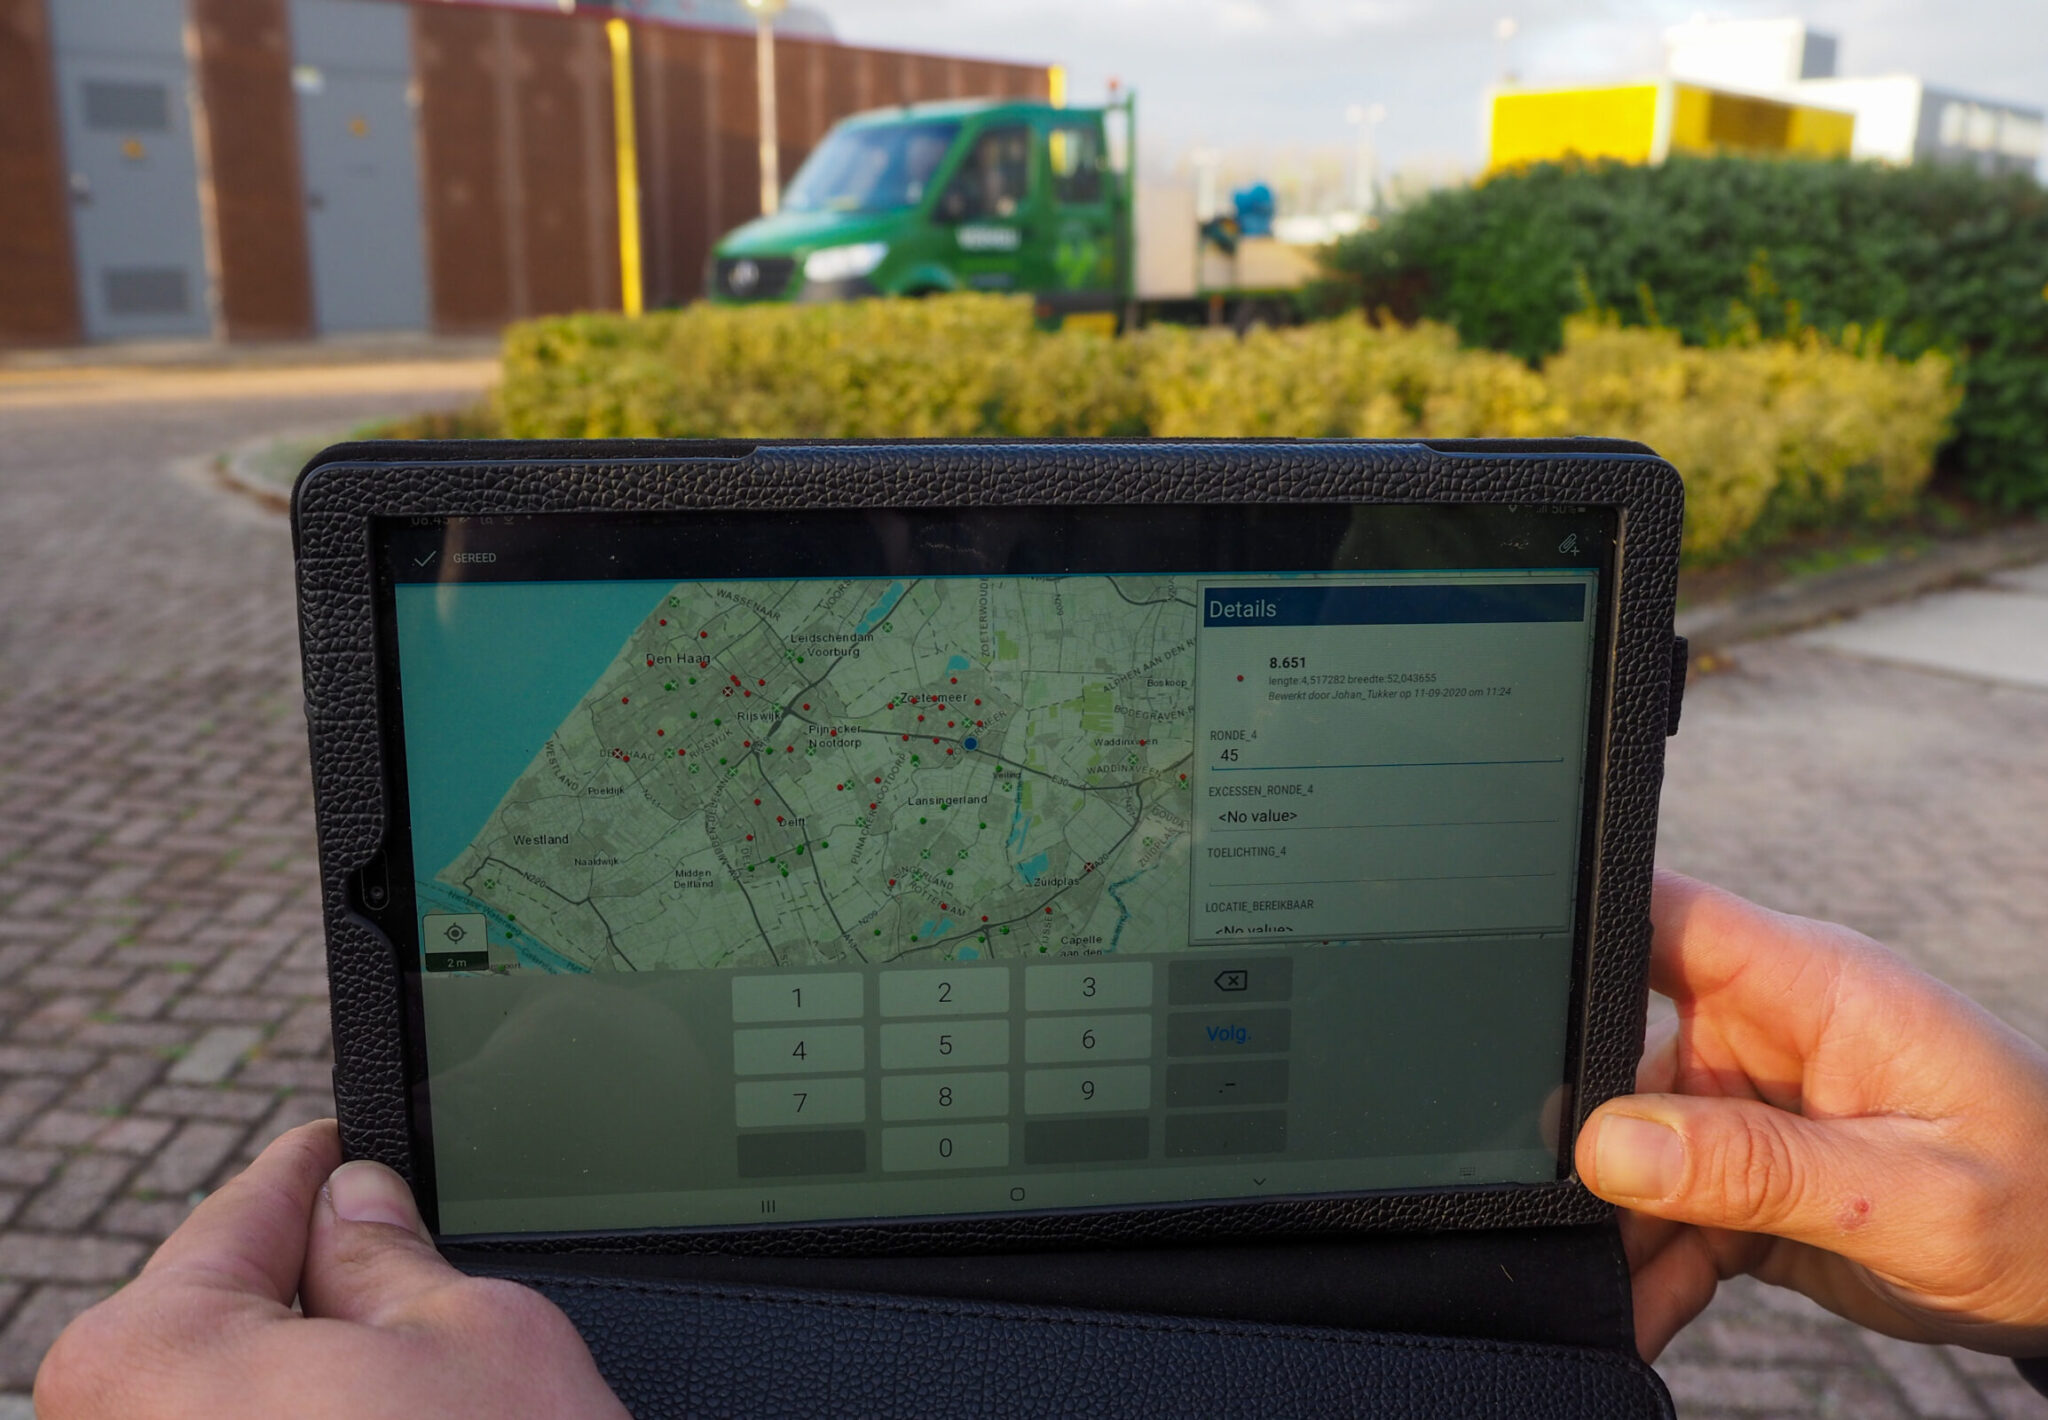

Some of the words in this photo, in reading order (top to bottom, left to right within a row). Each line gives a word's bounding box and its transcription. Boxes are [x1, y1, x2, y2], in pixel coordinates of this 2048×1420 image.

[453, 552, 497, 564] GEREED
[716, 587, 781, 622] WASSENAAR
[1210, 599, 1277, 619] Details
[790, 633, 875, 644] Leidschendam
[645, 653, 672, 665] Den
[676, 652, 711, 668] Haag
[807, 647, 860, 660] Voorburg
[1103, 667, 1141, 693] ALPHEN
[1143, 655, 1163, 672] AAN
[1164, 645, 1185, 661] DEN
[1269, 656, 1306, 669] 8.651
[1146, 679, 1187, 689] Boskoop
[900, 691, 968, 704] Zoetemeer
[1268, 691, 1306, 701] Bewerkt
[1308, 691, 1330, 701] door
[1400, 690, 1411, 701] op
[1415, 687, 1467, 698] 11-09-2020
[1469, 689, 1483, 697] om
[737, 710, 782, 723] Rijswijk
[1209, 728, 1257, 742] RONDE_4
[688, 727, 734, 760] RIJSWIJK
[808, 738, 862, 750] Nootdorp
[1220, 748, 1239, 762] 45
[545, 739, 580, 792] WESTLAND
[1086, 764, 1161, 778] WADDINXVEEN
[588, 785, 625, 797] Poeldijk
[1208, 784, 1314, 798] EXCESSEN_RONDE_4
[850, 750, 909, 865] PIJNACKERNOOTDORP
[907, 795, 988, 808] Lansingerland
[779, 818, 806, 828] Delft
[1218, 810, 1248, 824] <No
[1251, 809, 1298, 823] value>
[513, 834, 569, 846] Westland
[1207, 845, 1287, 859] TOELICHTING_4
[574, 857, 619, 868] Naaldwijk
[675, 869, 712, 879] Midden
[674, 880, 714, 890] Delfland
[1034, 878, 1080, 889] Zuidplas
[1205, 899, 1315, 914] LOCATIE_BEREIKBAAR
[1060, 936, 1103, 947] Capelle
[447, 958, 454, 968] 2
[456, 960, 467, 968] m
[938, 982, 953, 1003] 2
[1082, 976, 1096, 998] 3
[793, 987, 802, 1008] 1
[1082, 1029, 1096, 1050] 6
[1206, 1024, 1252, 1045] Volg.
[792, 1040, 807, 1061] 4
[938, 1035, 953, 1056] 5
[938, 1086, 953, 1107] 8
[1081, 1080, 1096, 1101] 9
[792, 1092, 807, 1113] 7
[938, 1138, 953, 1159] 0
